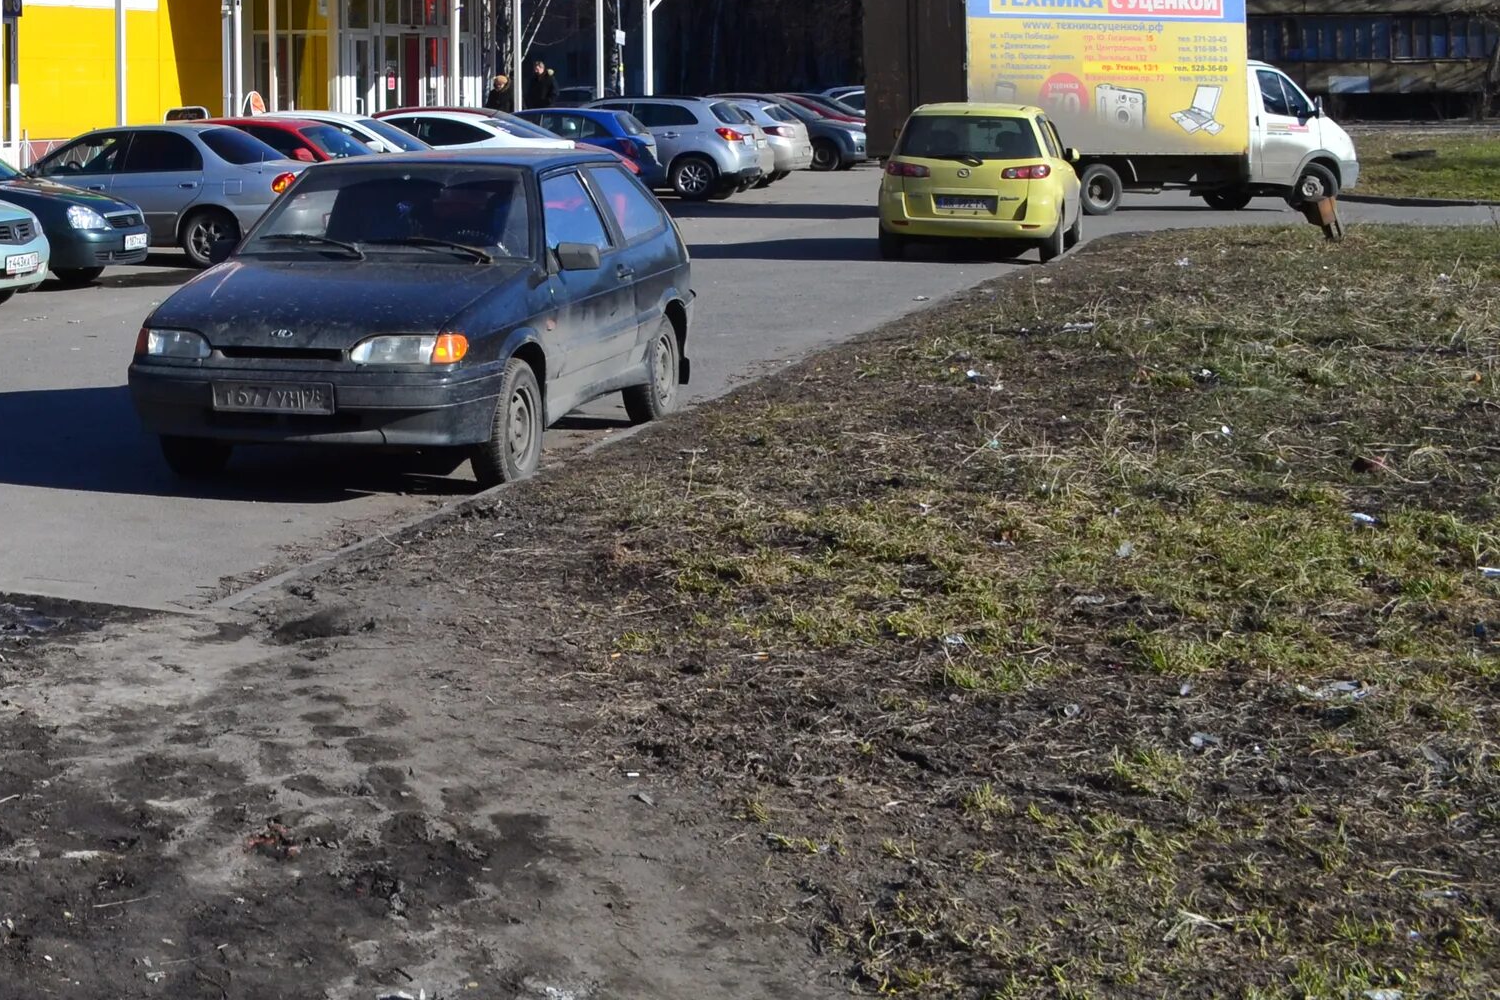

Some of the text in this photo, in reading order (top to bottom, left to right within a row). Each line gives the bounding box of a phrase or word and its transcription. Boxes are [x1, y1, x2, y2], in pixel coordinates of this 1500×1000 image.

[1056, 21, 1164, 34] техникасуценкой.рф
[1101, 65, 1114, 73] пр.
[1048, 82, 1079, 92] уценка
[1047, 91, 1081, 114] 70
